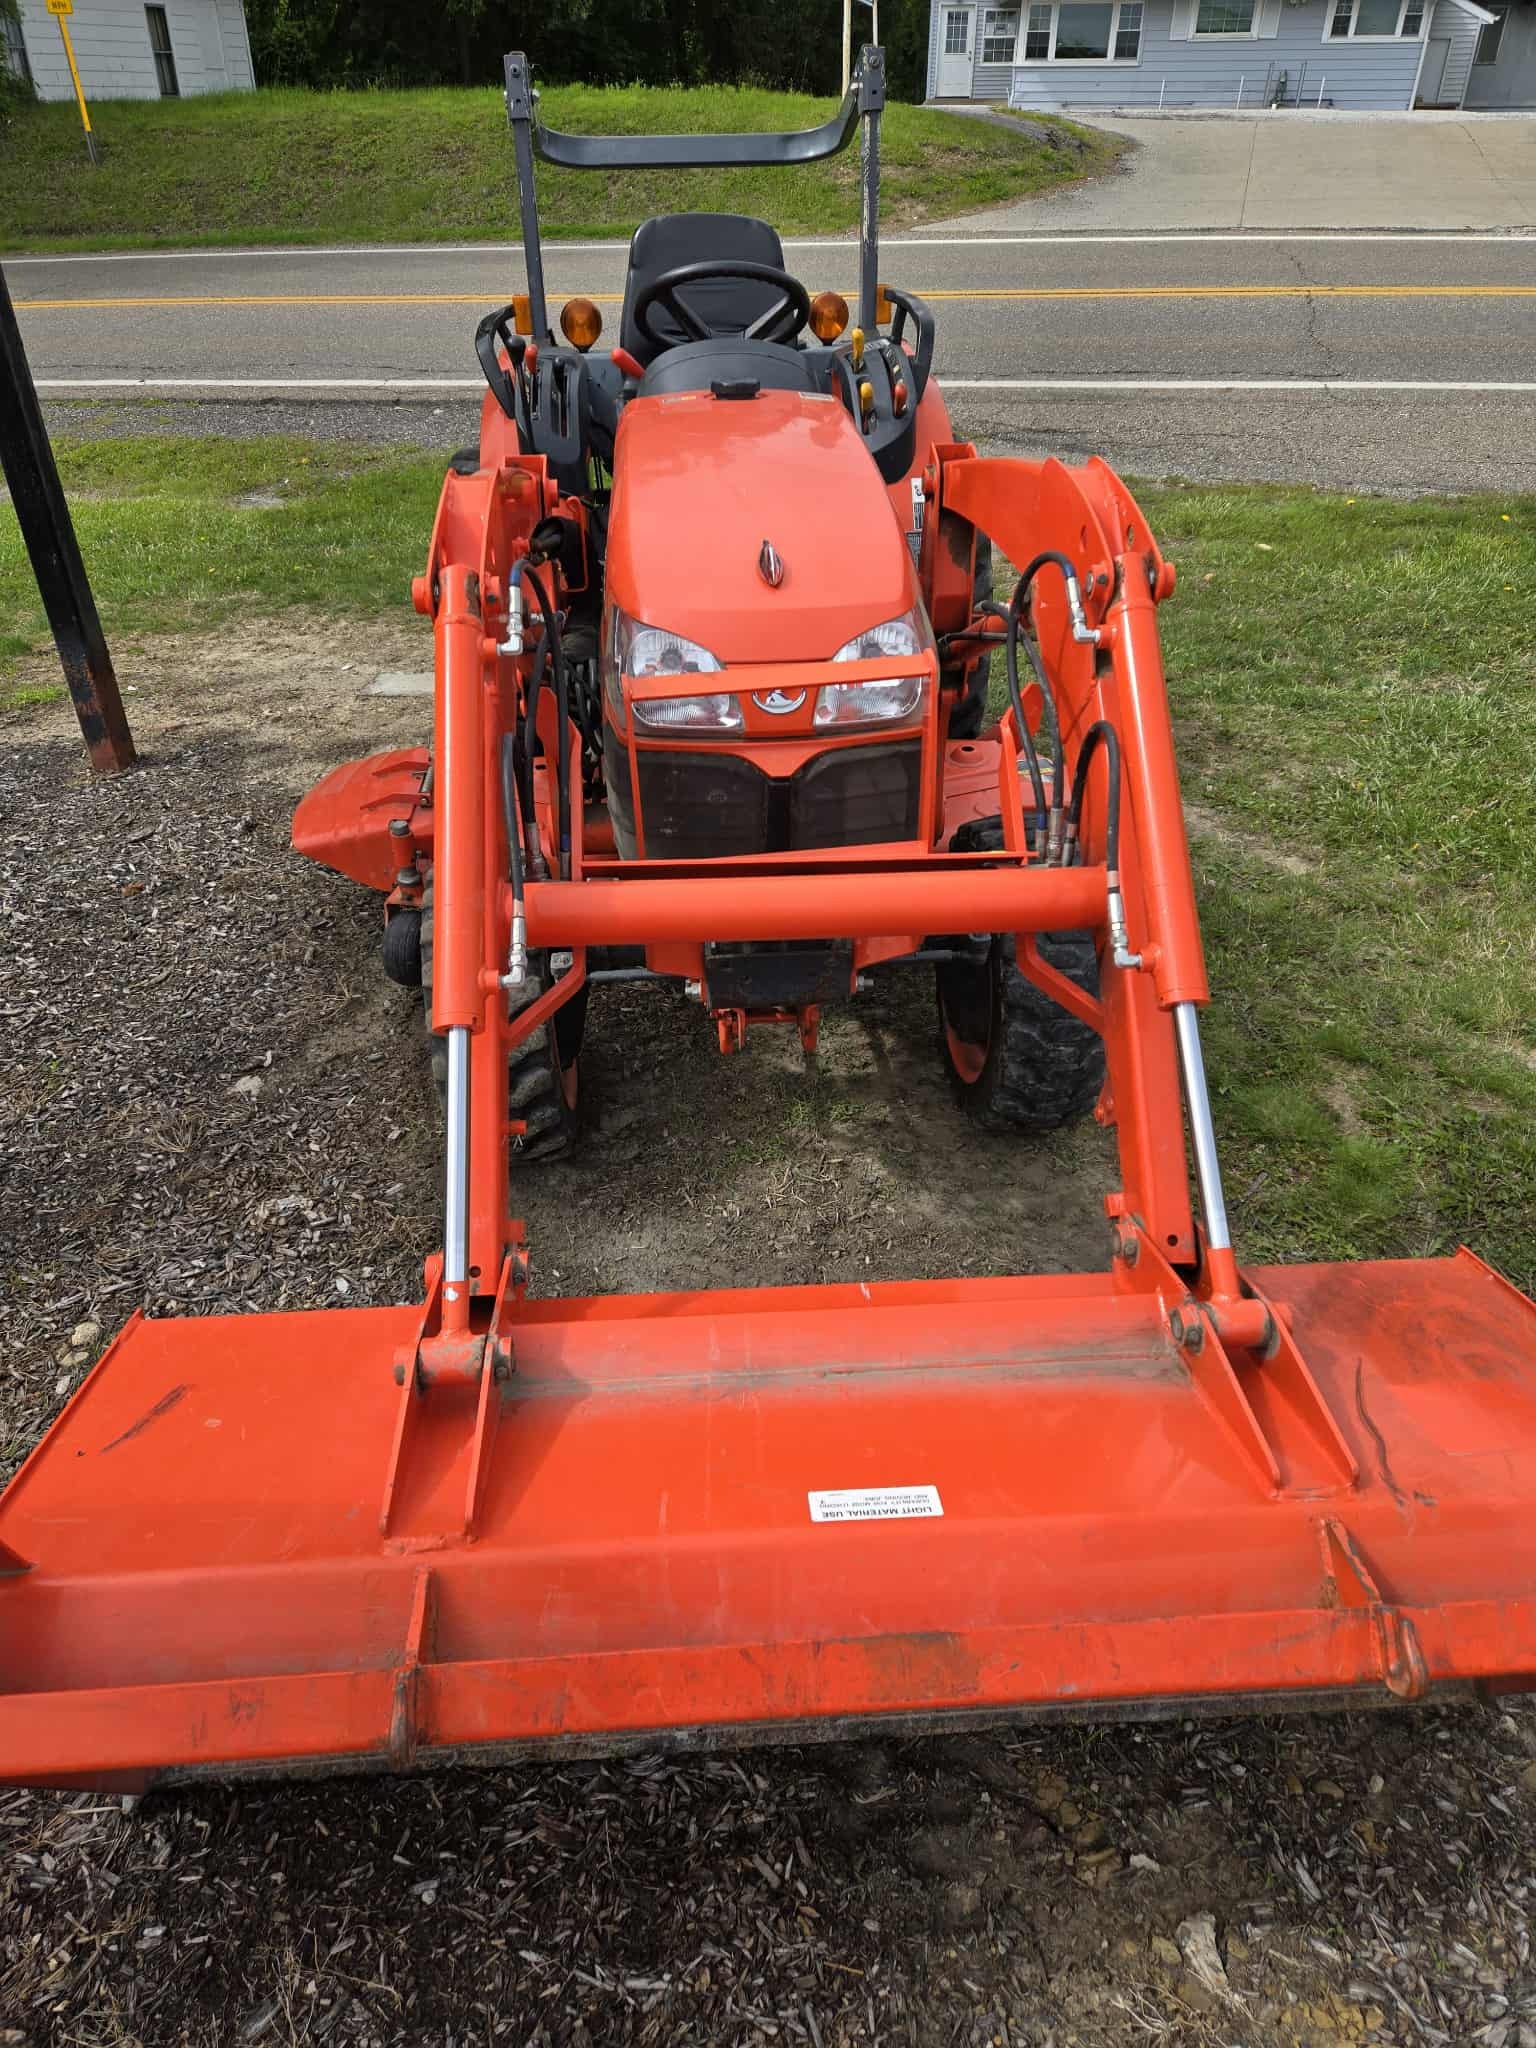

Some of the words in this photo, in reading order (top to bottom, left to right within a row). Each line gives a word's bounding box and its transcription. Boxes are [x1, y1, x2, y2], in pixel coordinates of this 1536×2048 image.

[849, 1508, 898, 1517] MATERIAL
[902, 1506, 933, 1514] LIGHT
[822, 1511, 844, 1519] USE
